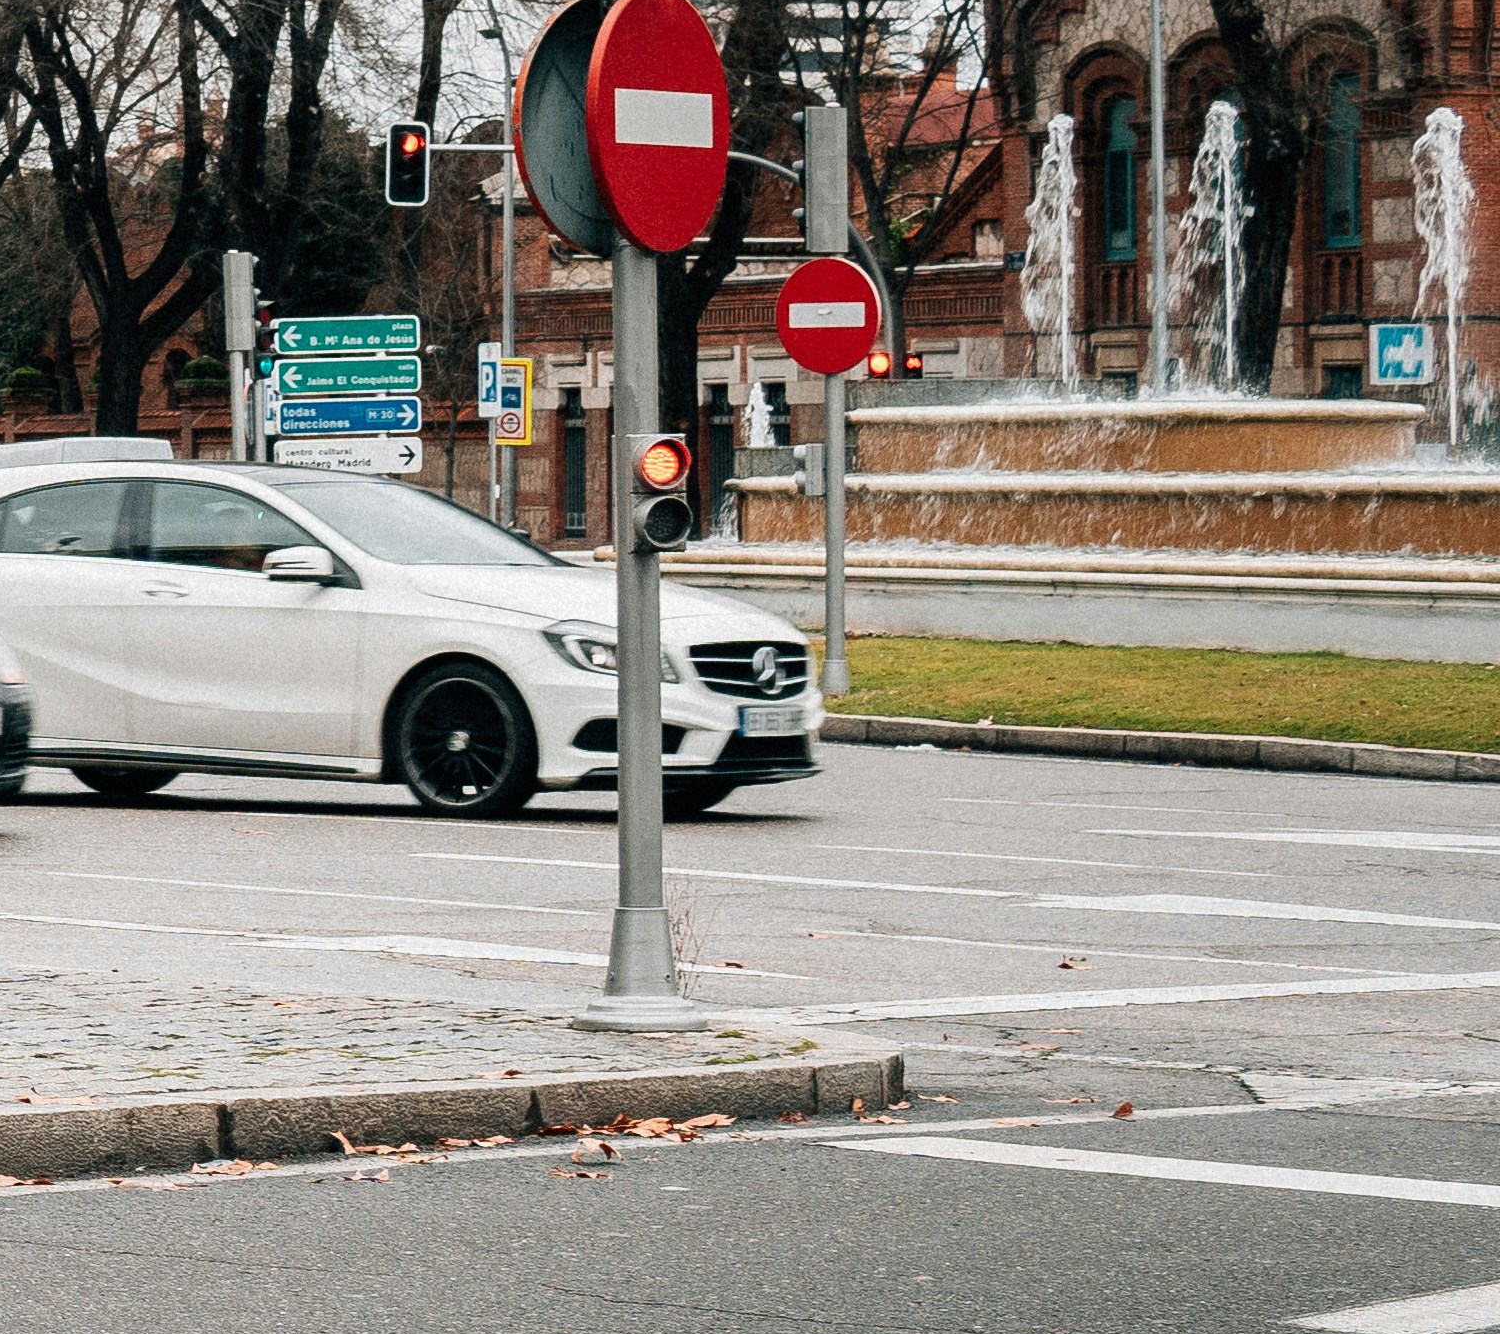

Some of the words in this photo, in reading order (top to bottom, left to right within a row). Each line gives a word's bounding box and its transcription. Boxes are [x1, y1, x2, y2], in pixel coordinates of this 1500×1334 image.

[309, 336, 322, 346] B.
[342, 335, 363, 345] Ana
[367, 335, 381, 344] de
[385, 333, 414, 344] Jesús
[307, 377, 334, 386] Jaime
[337, 376, 347, 385] El
[351, 374, 415, 387] Conquistador
[282, 406, 317, 417] todas
[282, 419, 350, 430] direcciones
[285, 447, 314, 457] centro
[318, 446, 353, 456] cultural
[337, 459, 372, 468] Madrid
